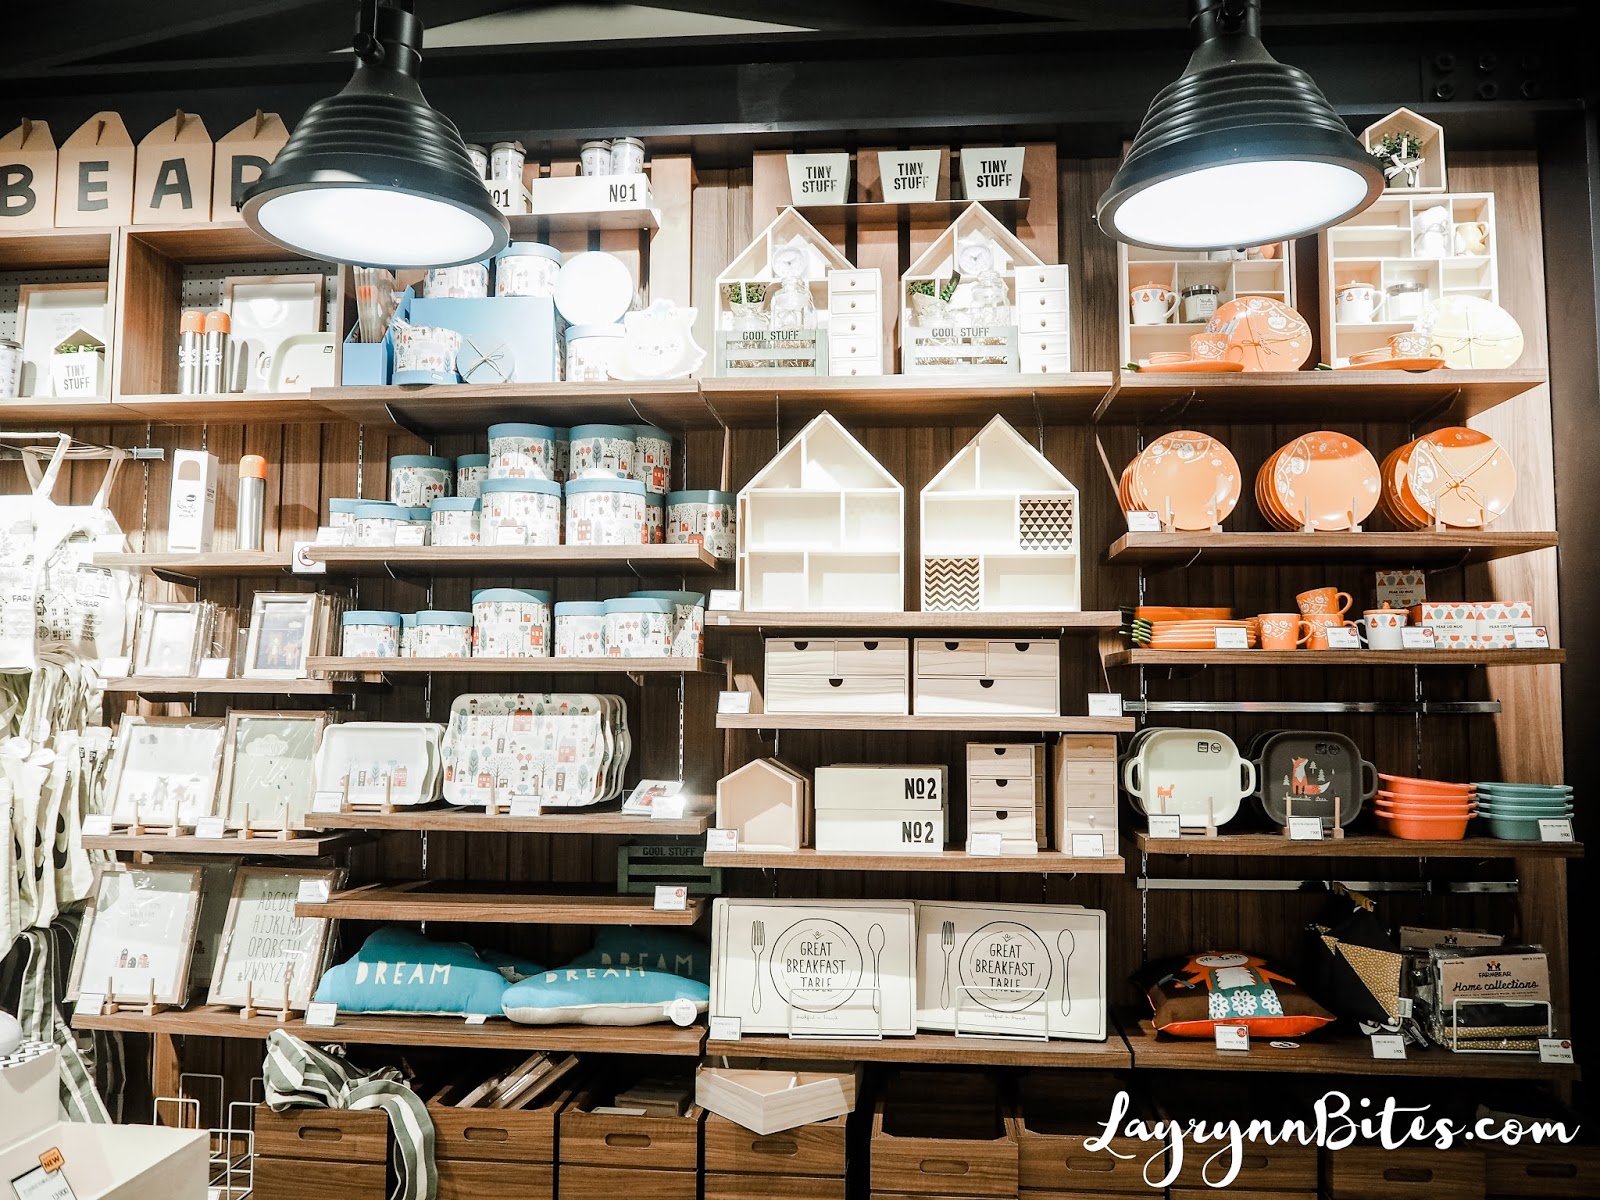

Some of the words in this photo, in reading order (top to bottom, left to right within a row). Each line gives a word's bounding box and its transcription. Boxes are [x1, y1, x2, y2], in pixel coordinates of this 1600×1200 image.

[806, 166, 832, 179] TINY
[898, 162, 924, 176] TINY
[980, 160, 1006, 173] TINY
[802, 180, 837, 193] STUFF
[894, 176, 929, 190] STUFF
[976, 174, 1012, 188] STUFF
[770, 330, 799, 340] STUFF
[960, 328, 990, 337] STUFF
[65, 364, 85, 377] TINY
[64, 376, 90, 390] STUFF
[668, 847, 696, 856] STUFF
[800, 942, 832, 956] GREAT
[989, 943, 1022, 958] GREAT
[244, 961, 284, 982] VWXYZ
[355, 961, 451, 985] DREAM
[786, 958, 846, 974] BREAKFAST
[975, 959, 1035, 976] BREAKFAST
[546, 965, 646, 983] DREAM
[800, 977, 832, 992] TABLE
[989, 977, 1022, 993] TABLE
[1453, 982, 1482, 992] Home
[1484, 979, 1538, 990] collections
[44, 1156, 60, 1168] NEW
